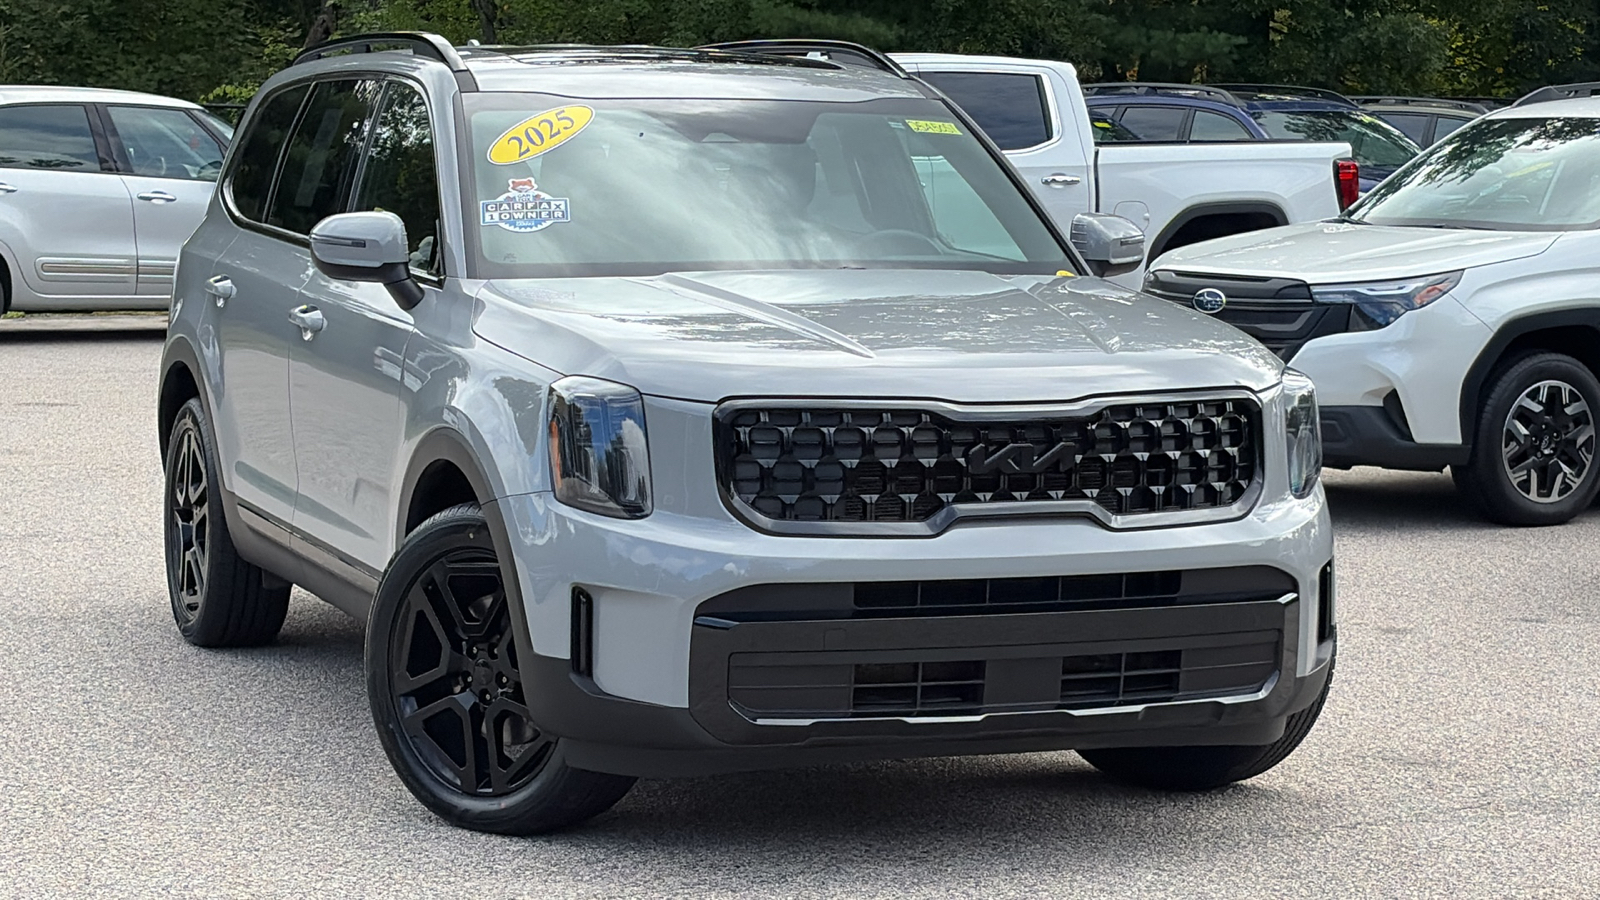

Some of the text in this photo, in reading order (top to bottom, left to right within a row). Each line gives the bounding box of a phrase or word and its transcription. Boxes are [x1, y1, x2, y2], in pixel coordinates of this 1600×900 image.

[507, 109, 575, 158] 2025
[487, 202, 562, 212] CARFAX
[488, 211, 564, 221] 1 OWNER
[967, 442, 1076, 474] KIA
